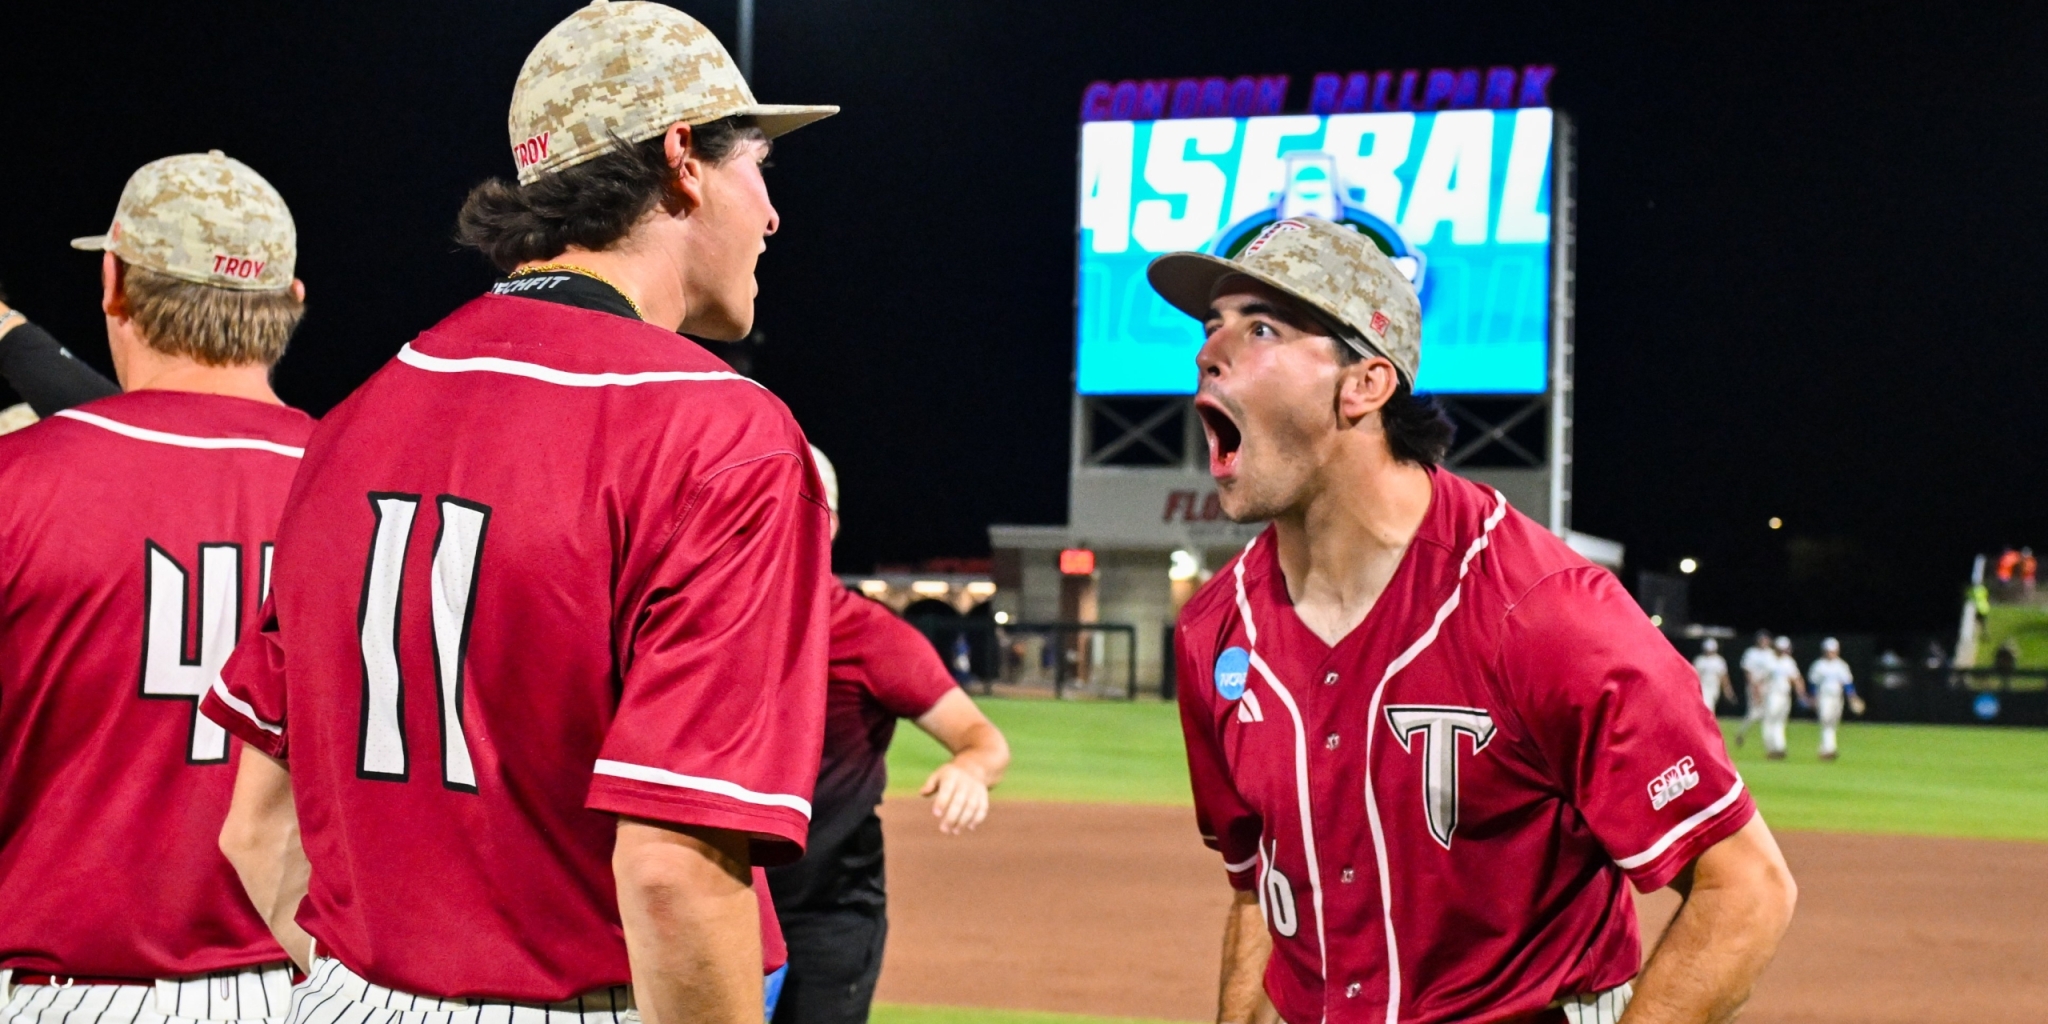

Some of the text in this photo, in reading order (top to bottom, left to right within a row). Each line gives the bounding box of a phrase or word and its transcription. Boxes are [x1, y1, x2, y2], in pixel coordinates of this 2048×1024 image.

[1309, 65, 1556, 115] BALLPARK
[513, 131, 549, 169] TROY
[213, 254, 265, 279] TROY
[138, 537, 275, 765] 4
[356, 488, 492, 796] 11
[1383, 704, 1498, 851] T
[1647, 755, 1699, 811] SBC
